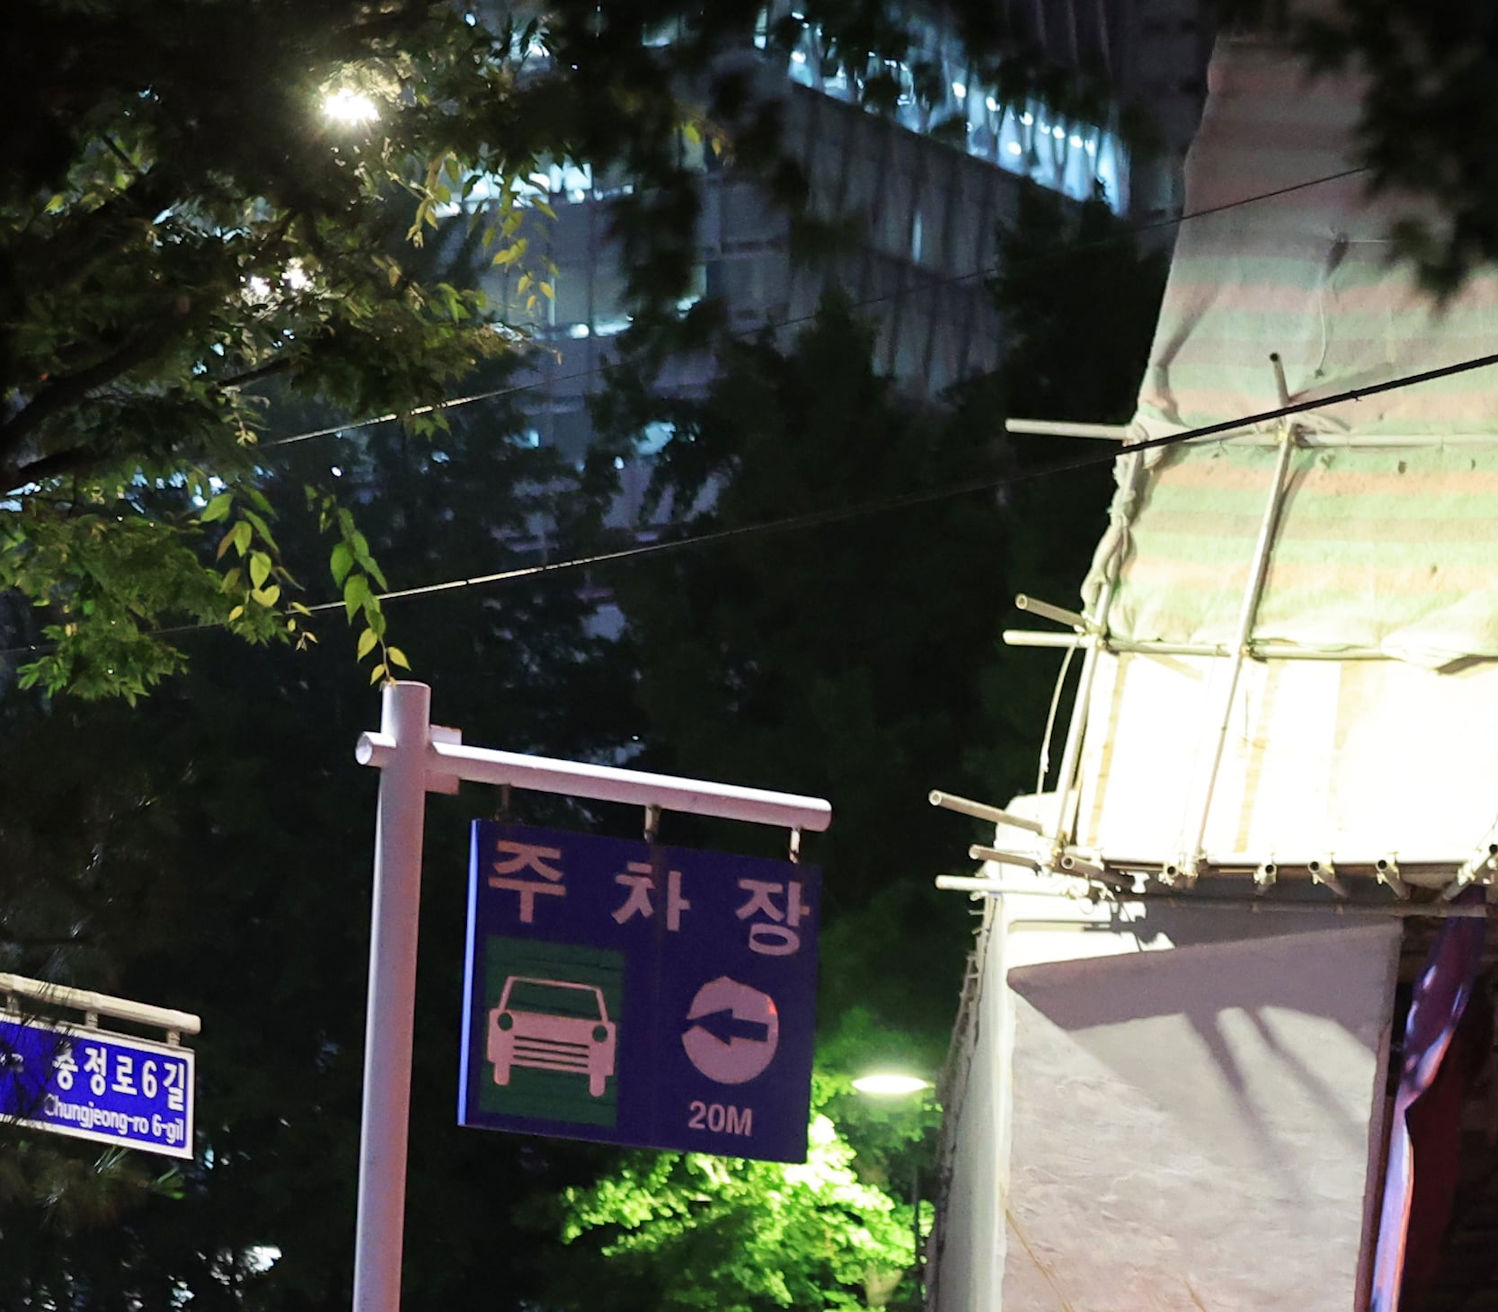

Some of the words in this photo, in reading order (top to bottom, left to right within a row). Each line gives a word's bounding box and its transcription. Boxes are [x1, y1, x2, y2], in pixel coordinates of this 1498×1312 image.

[488, 840, 810, 956] 주차장
[152, 1113, 185, 1144] 6-gil
[688, 1101, 753, 1136] 20M
